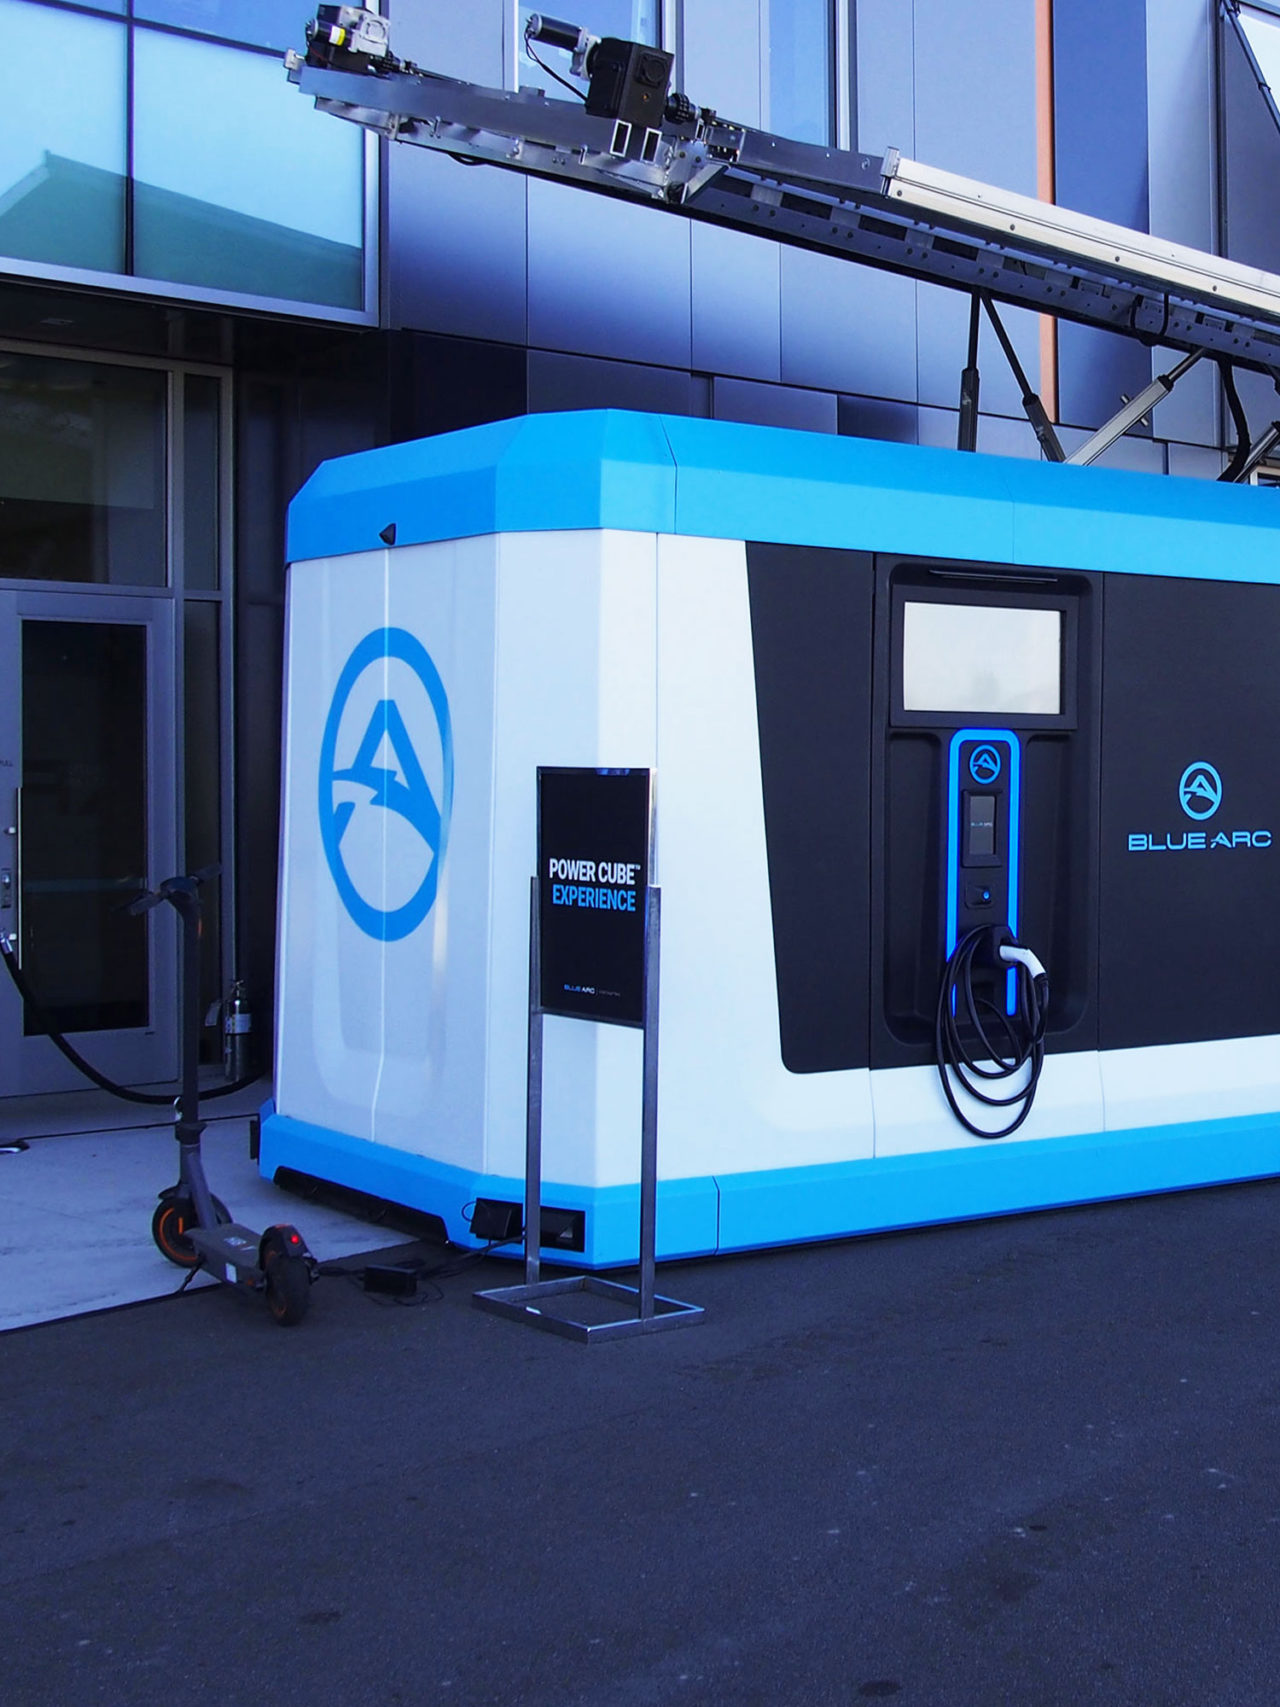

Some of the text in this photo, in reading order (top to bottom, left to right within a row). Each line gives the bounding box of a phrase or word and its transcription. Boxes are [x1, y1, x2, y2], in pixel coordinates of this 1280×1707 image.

[1128, 830, 1272, 851] BLUE ARC
[549, 858, 596, 882] POWER
[552, 884, 636, 912] EXPERIENCE
